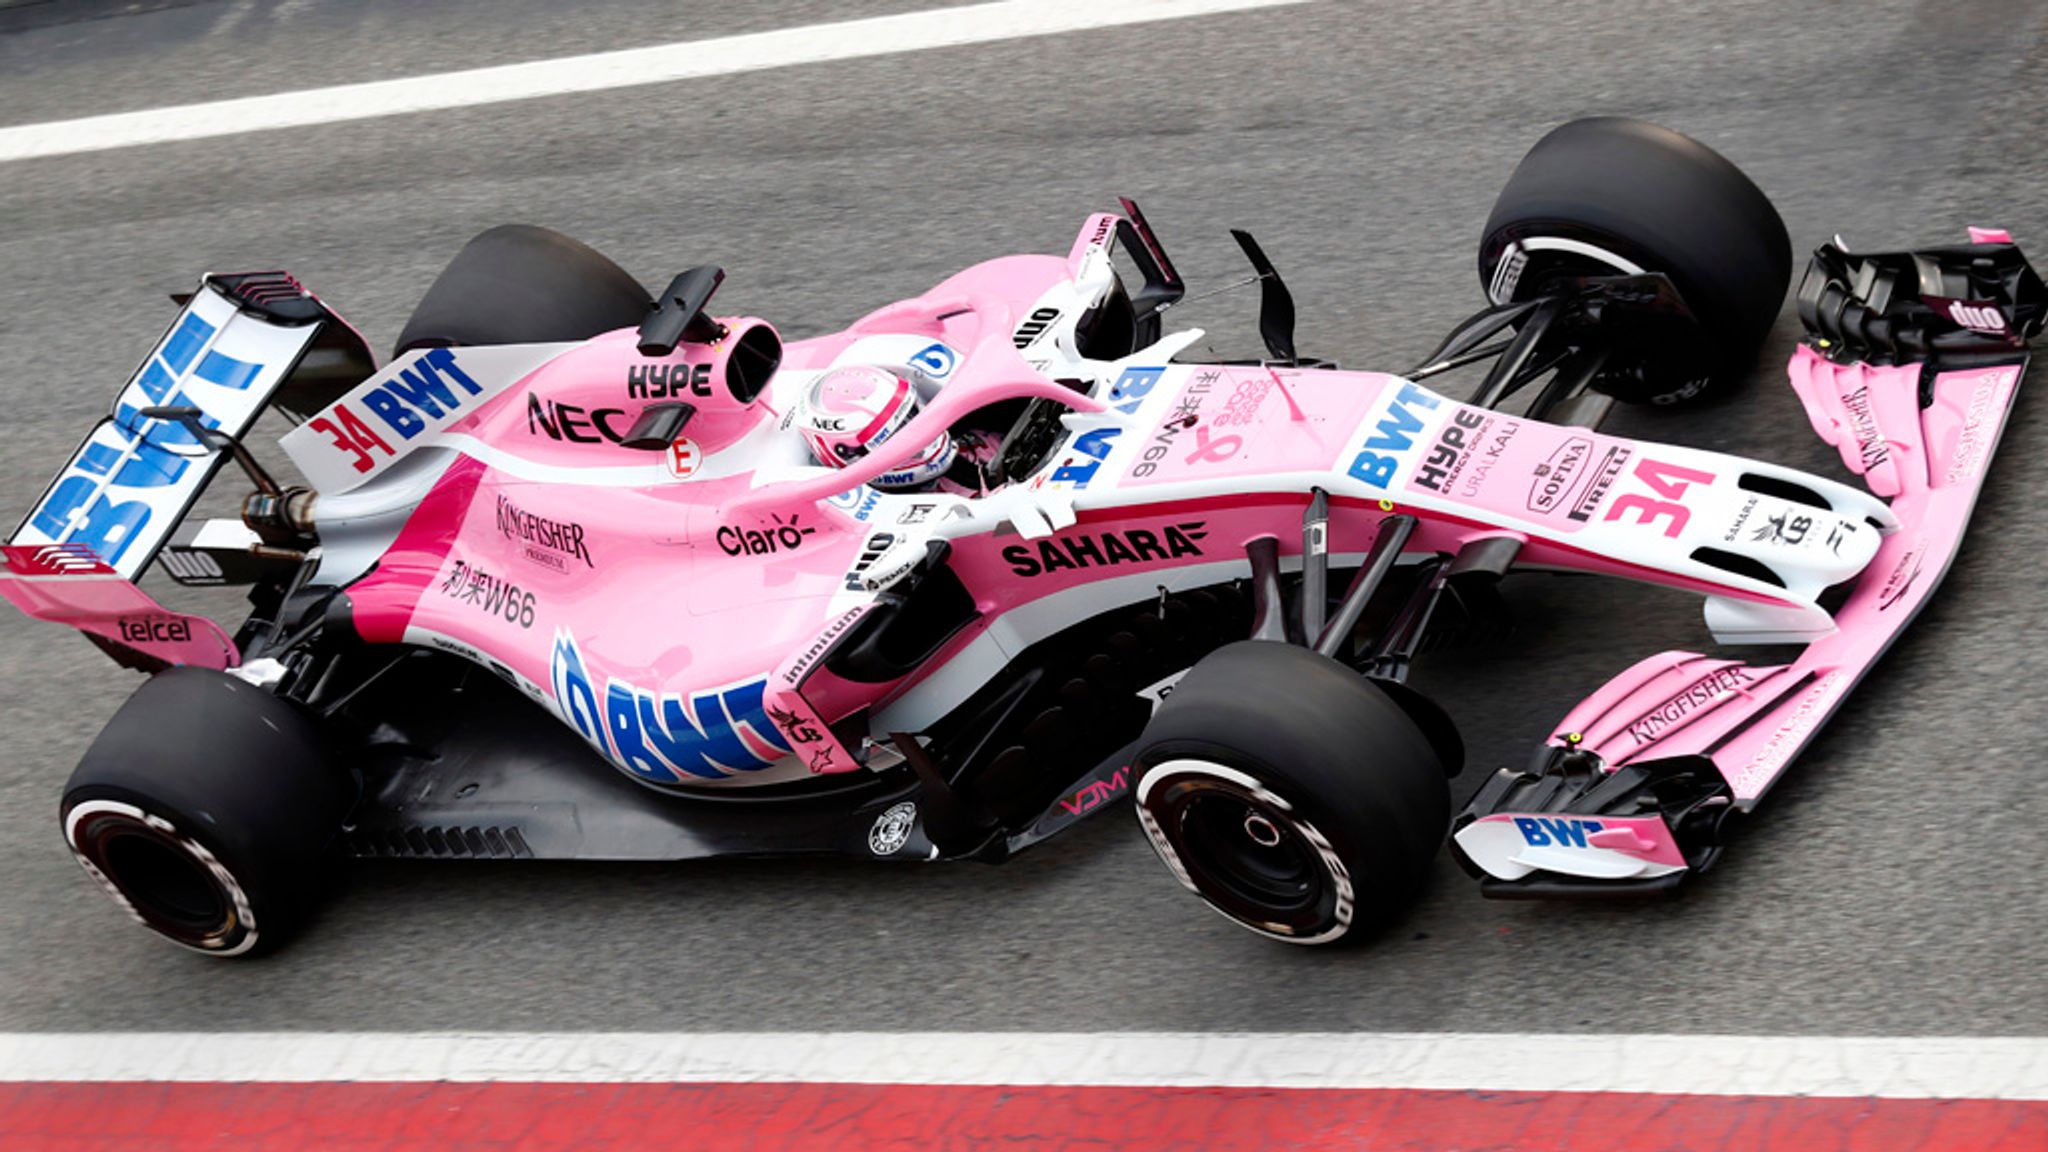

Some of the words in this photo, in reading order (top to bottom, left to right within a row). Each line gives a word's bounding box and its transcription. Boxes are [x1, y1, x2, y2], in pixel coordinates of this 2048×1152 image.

[1949, 300, 2005, 329] duo
[361, 347, 484, 440] BWT
[628, 363, 712, 399] HYPE
[30, 310, 265, 567] BWT
[308, 403, 397, 474] 34
[528, 391, 634, 444] NEC
[812, 417, 845, 431] NEC
[1347, 380, 1442, 489] BWT
[673, 440, 692, 473] E
[1414, 409, 1485, 491] HYPE
[1461, 421, 1521, 497] URALKALI
[1536, 444, 1587, 508] SOFINA
[855, 490, 882, 520] BWT
[1568, 446, 1632, 523] PIRELLI
[1603, 458, 1717, 538] 34
[496, 494, 595, 569] KINGFISHER
[716, 517, 808, 556] Claro
[1002, 523, 1204, 576] SAHARA
[1725, 499, 1759, 542] SAHARA
[159, 550, 223, 578] duo
[119, 619, 191, 642] telcel
[782, 606, 863, 684] infinitum
[606, 678, 794, 782] BWT
[1628, 664, 1754, 746] KINGFISHER
[1060, 767, 1129, 815] VJM
